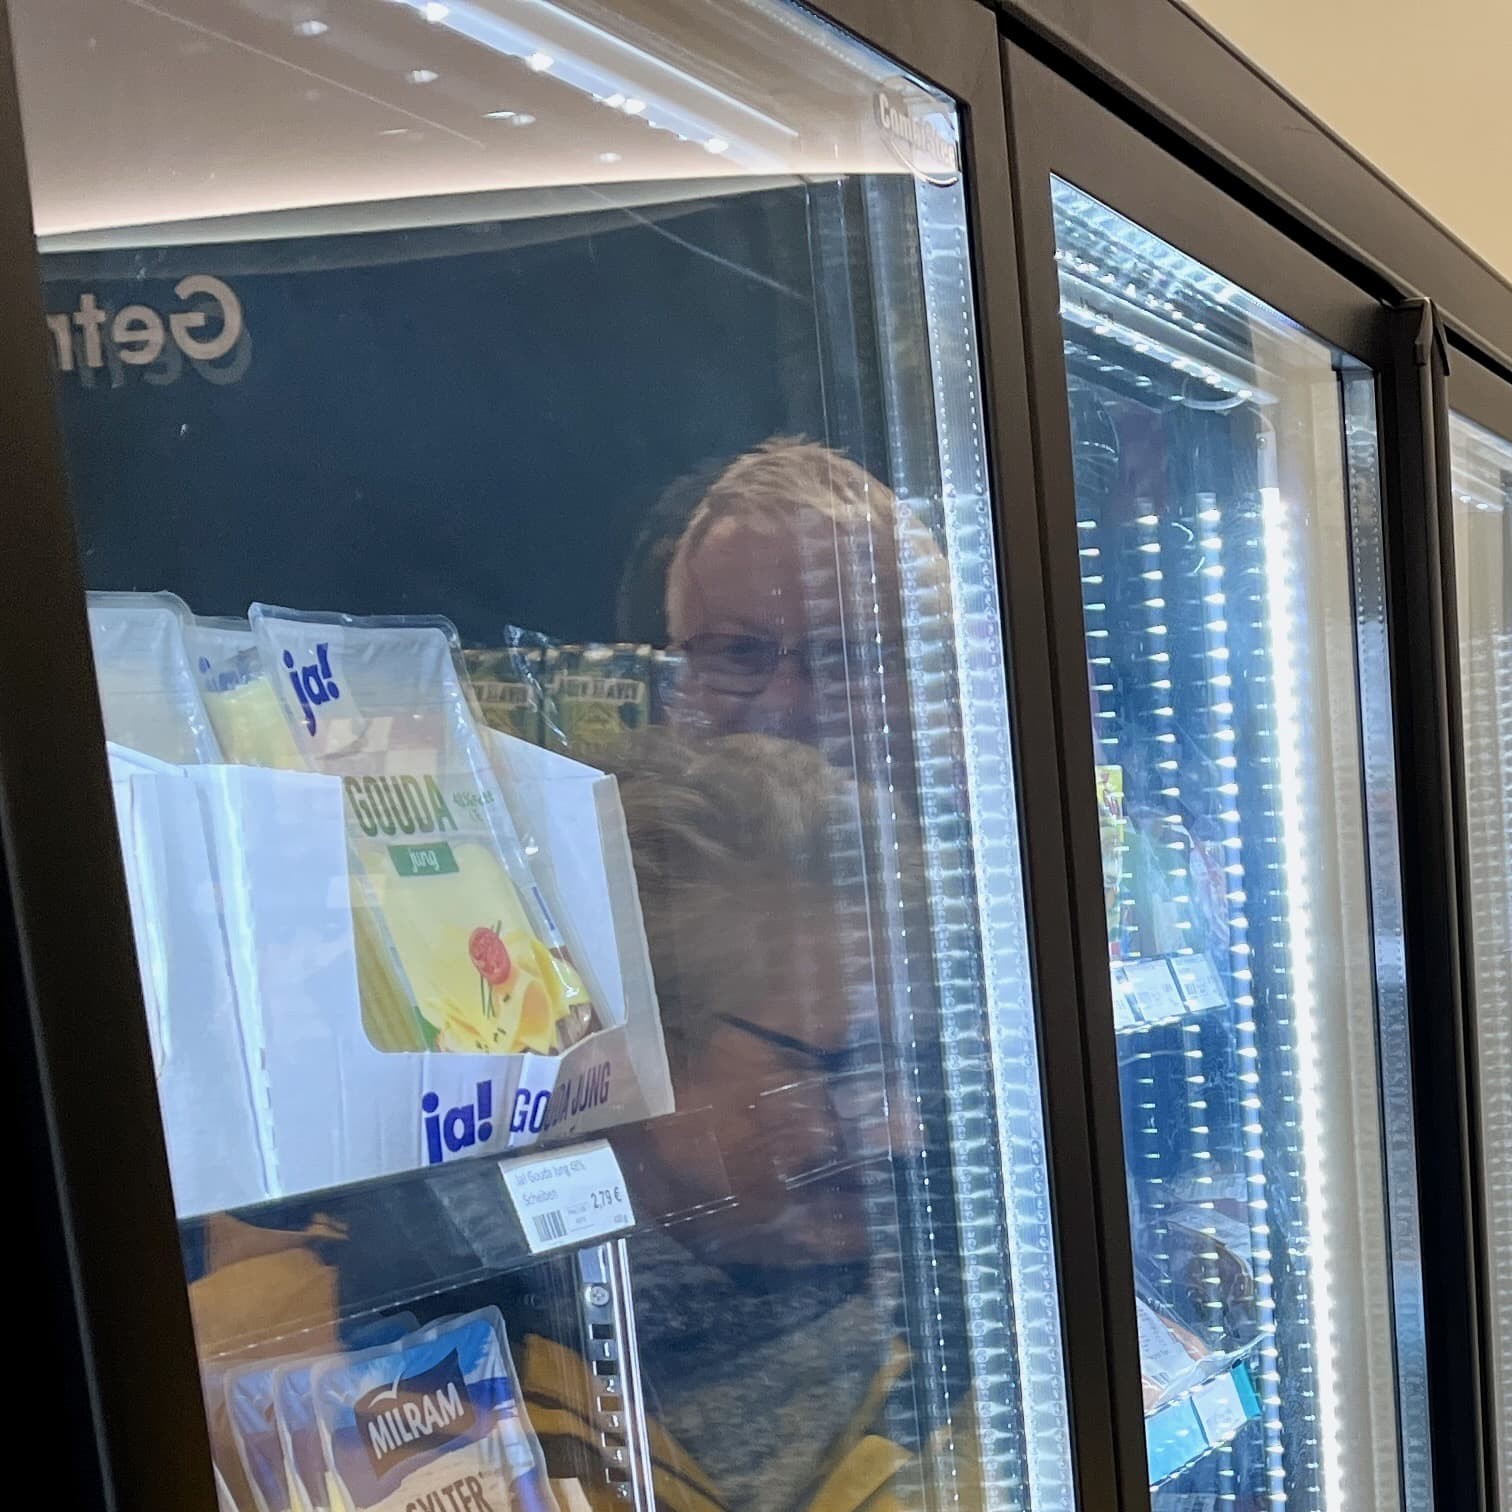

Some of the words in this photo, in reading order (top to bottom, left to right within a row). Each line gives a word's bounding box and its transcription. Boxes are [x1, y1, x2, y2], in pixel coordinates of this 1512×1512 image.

[283, 642, 340, 737] ja!
[344, 775, 458, 837] GOUDA
[409, 849, 440, 872] jung
[422, 1080, 493, 1165] ja!
[591, 1190, 613, 1209] 2,79
[613, 1186, 622, 1202] €
[367, 1381, 464, 1460] MILRAM
